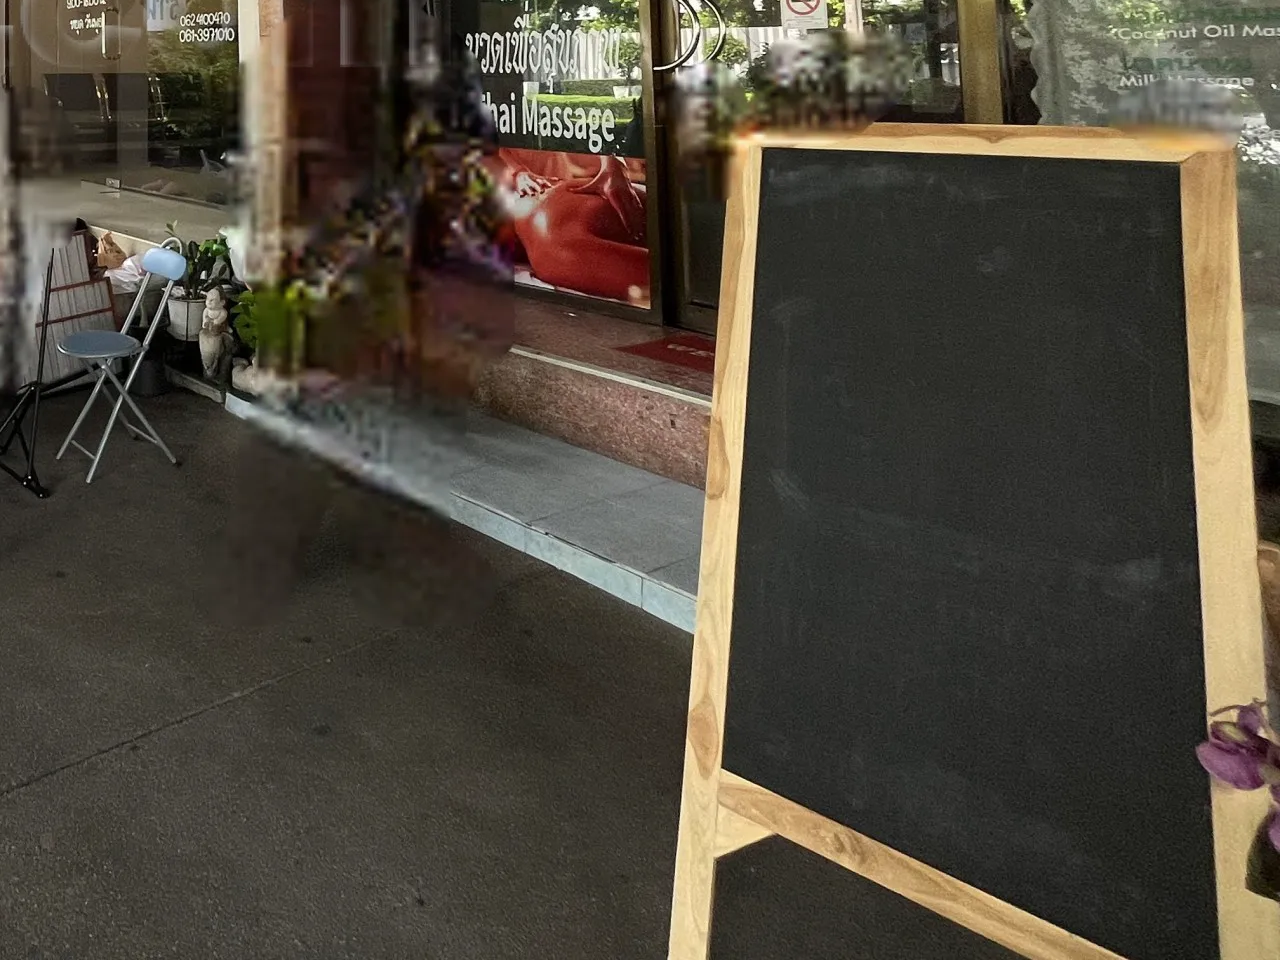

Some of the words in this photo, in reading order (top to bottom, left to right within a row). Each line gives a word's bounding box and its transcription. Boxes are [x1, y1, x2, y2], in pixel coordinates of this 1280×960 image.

[1204, 24, 1235, 37] Oil
[480, 92, 516, 134] hai
[522, 95, 615, 153] Massage
